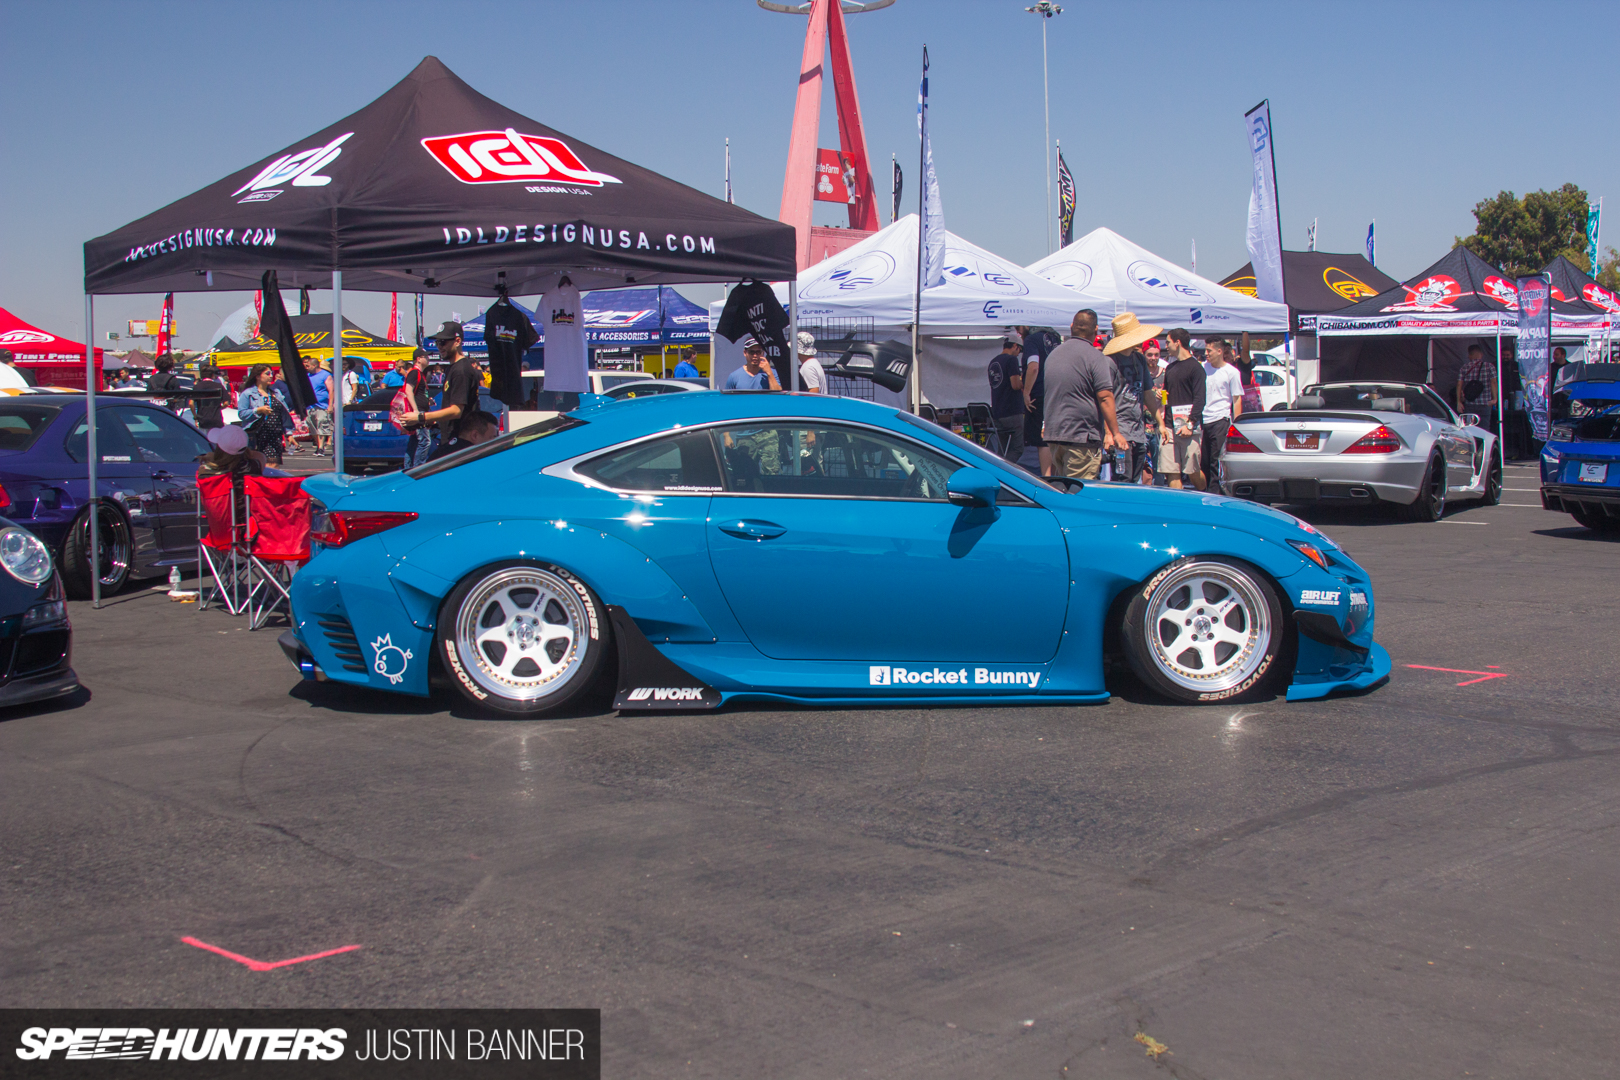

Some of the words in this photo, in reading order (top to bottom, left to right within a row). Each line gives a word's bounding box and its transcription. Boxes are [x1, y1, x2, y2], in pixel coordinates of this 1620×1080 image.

[816, 163, 826, 172] ate
[826, 164, 839, 174] Farm
[525, 186, 568, 194] DESIGN
[568, 187, 593, 197] USA
[443, 224, 716, 254] IDLDESIGNUSA.COM
[1319, 320, 1398, 329] ICHIBANJDM.COM
[598, 332, 649, 341] ACCESSORIES
[1321, 590, 1341, 601] LIFT
[445, 639, 488, 700] PROXES
[893, 668, 968, 684] Rocket
[975, 668, 1041, 688] Bunny
